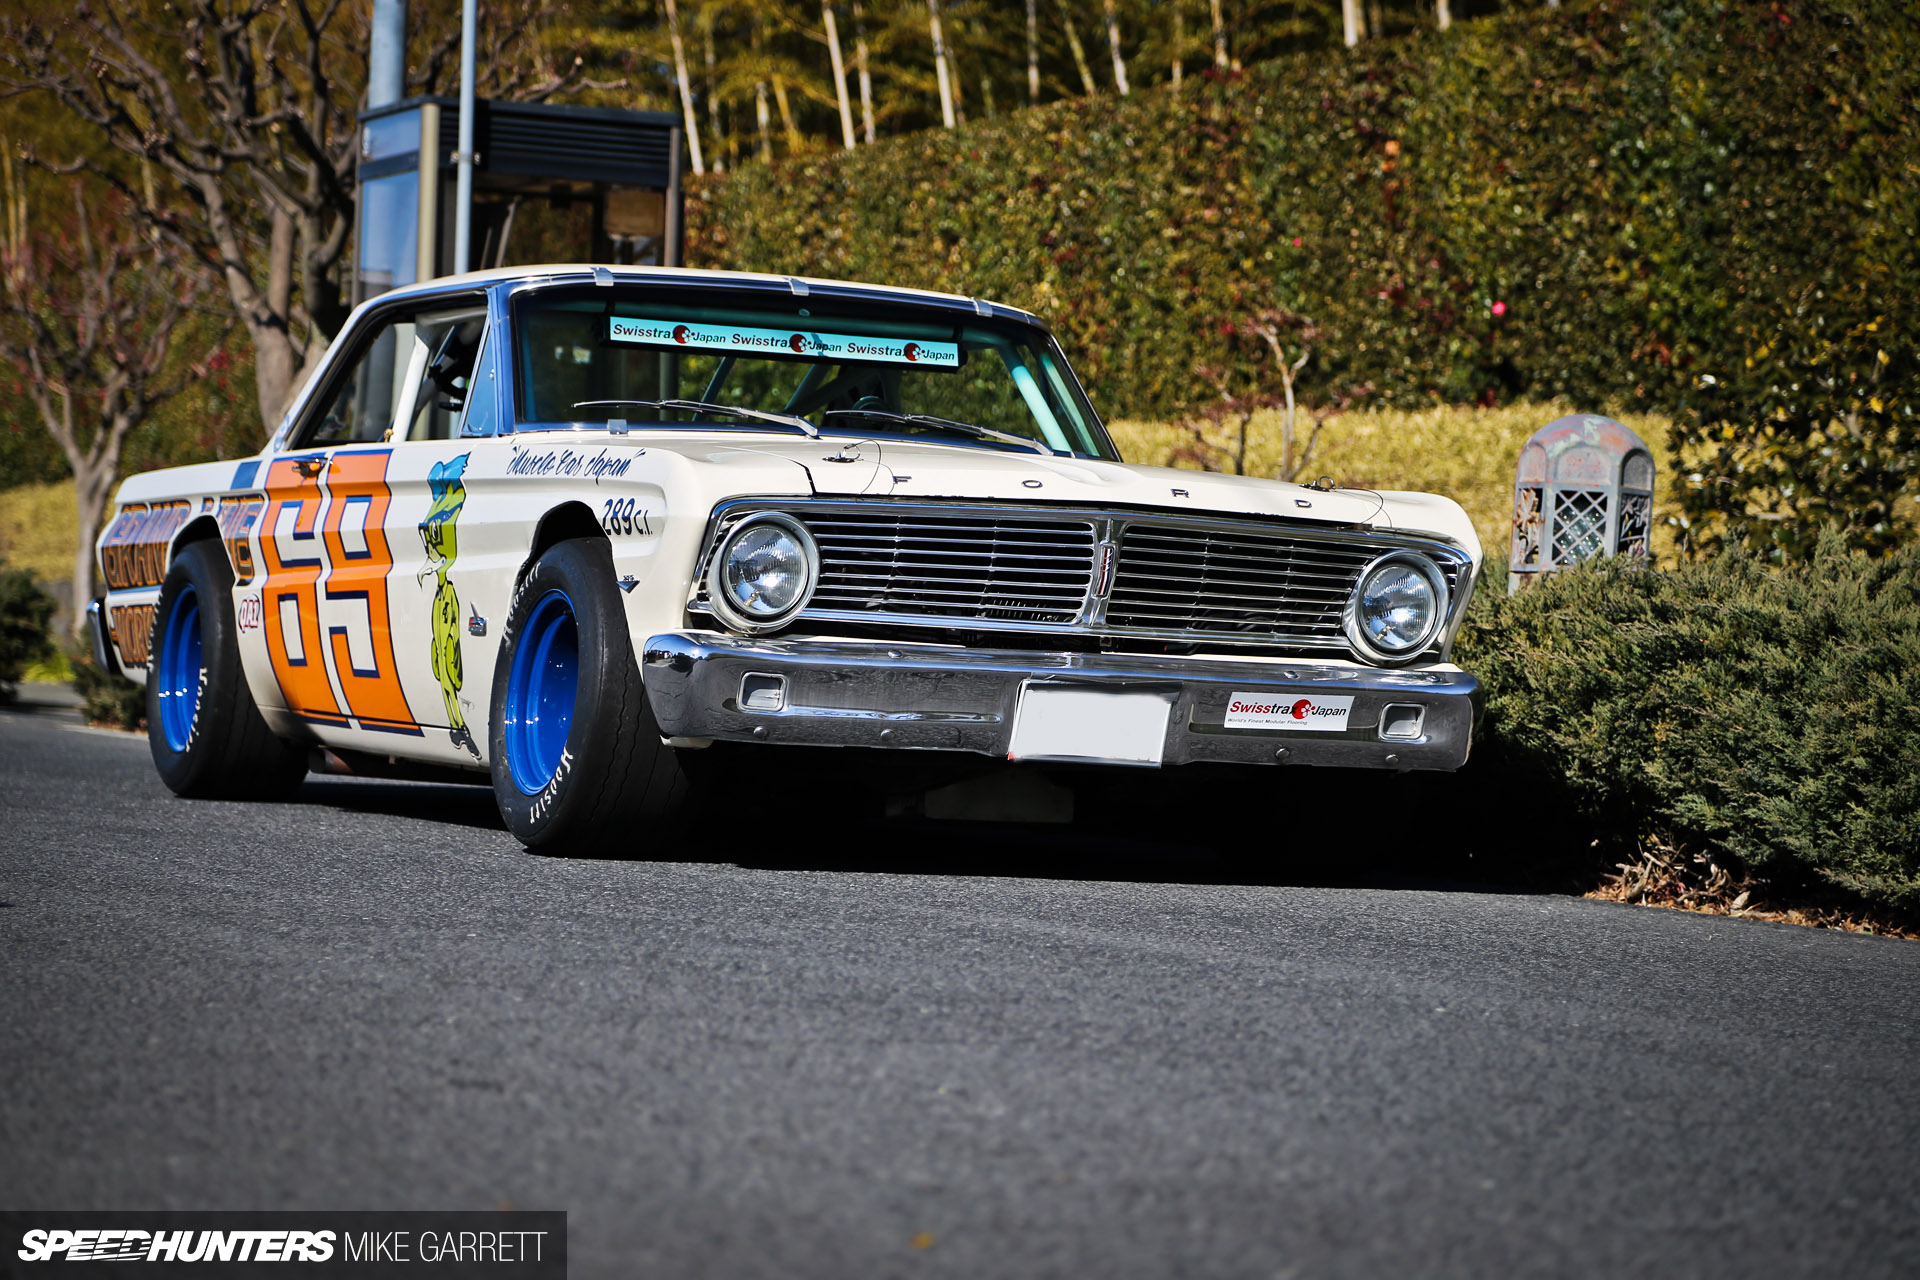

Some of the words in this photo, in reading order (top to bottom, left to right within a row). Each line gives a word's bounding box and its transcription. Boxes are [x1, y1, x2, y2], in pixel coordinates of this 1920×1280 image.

[693, 332, 726, 343] Japan
[809, 340, 842, 352] Japan
[923, 349, 955, 361] Japan
[1230, 701, 1299, 715] Swisstrax
[1312, 705, 1347, 718] Japan
